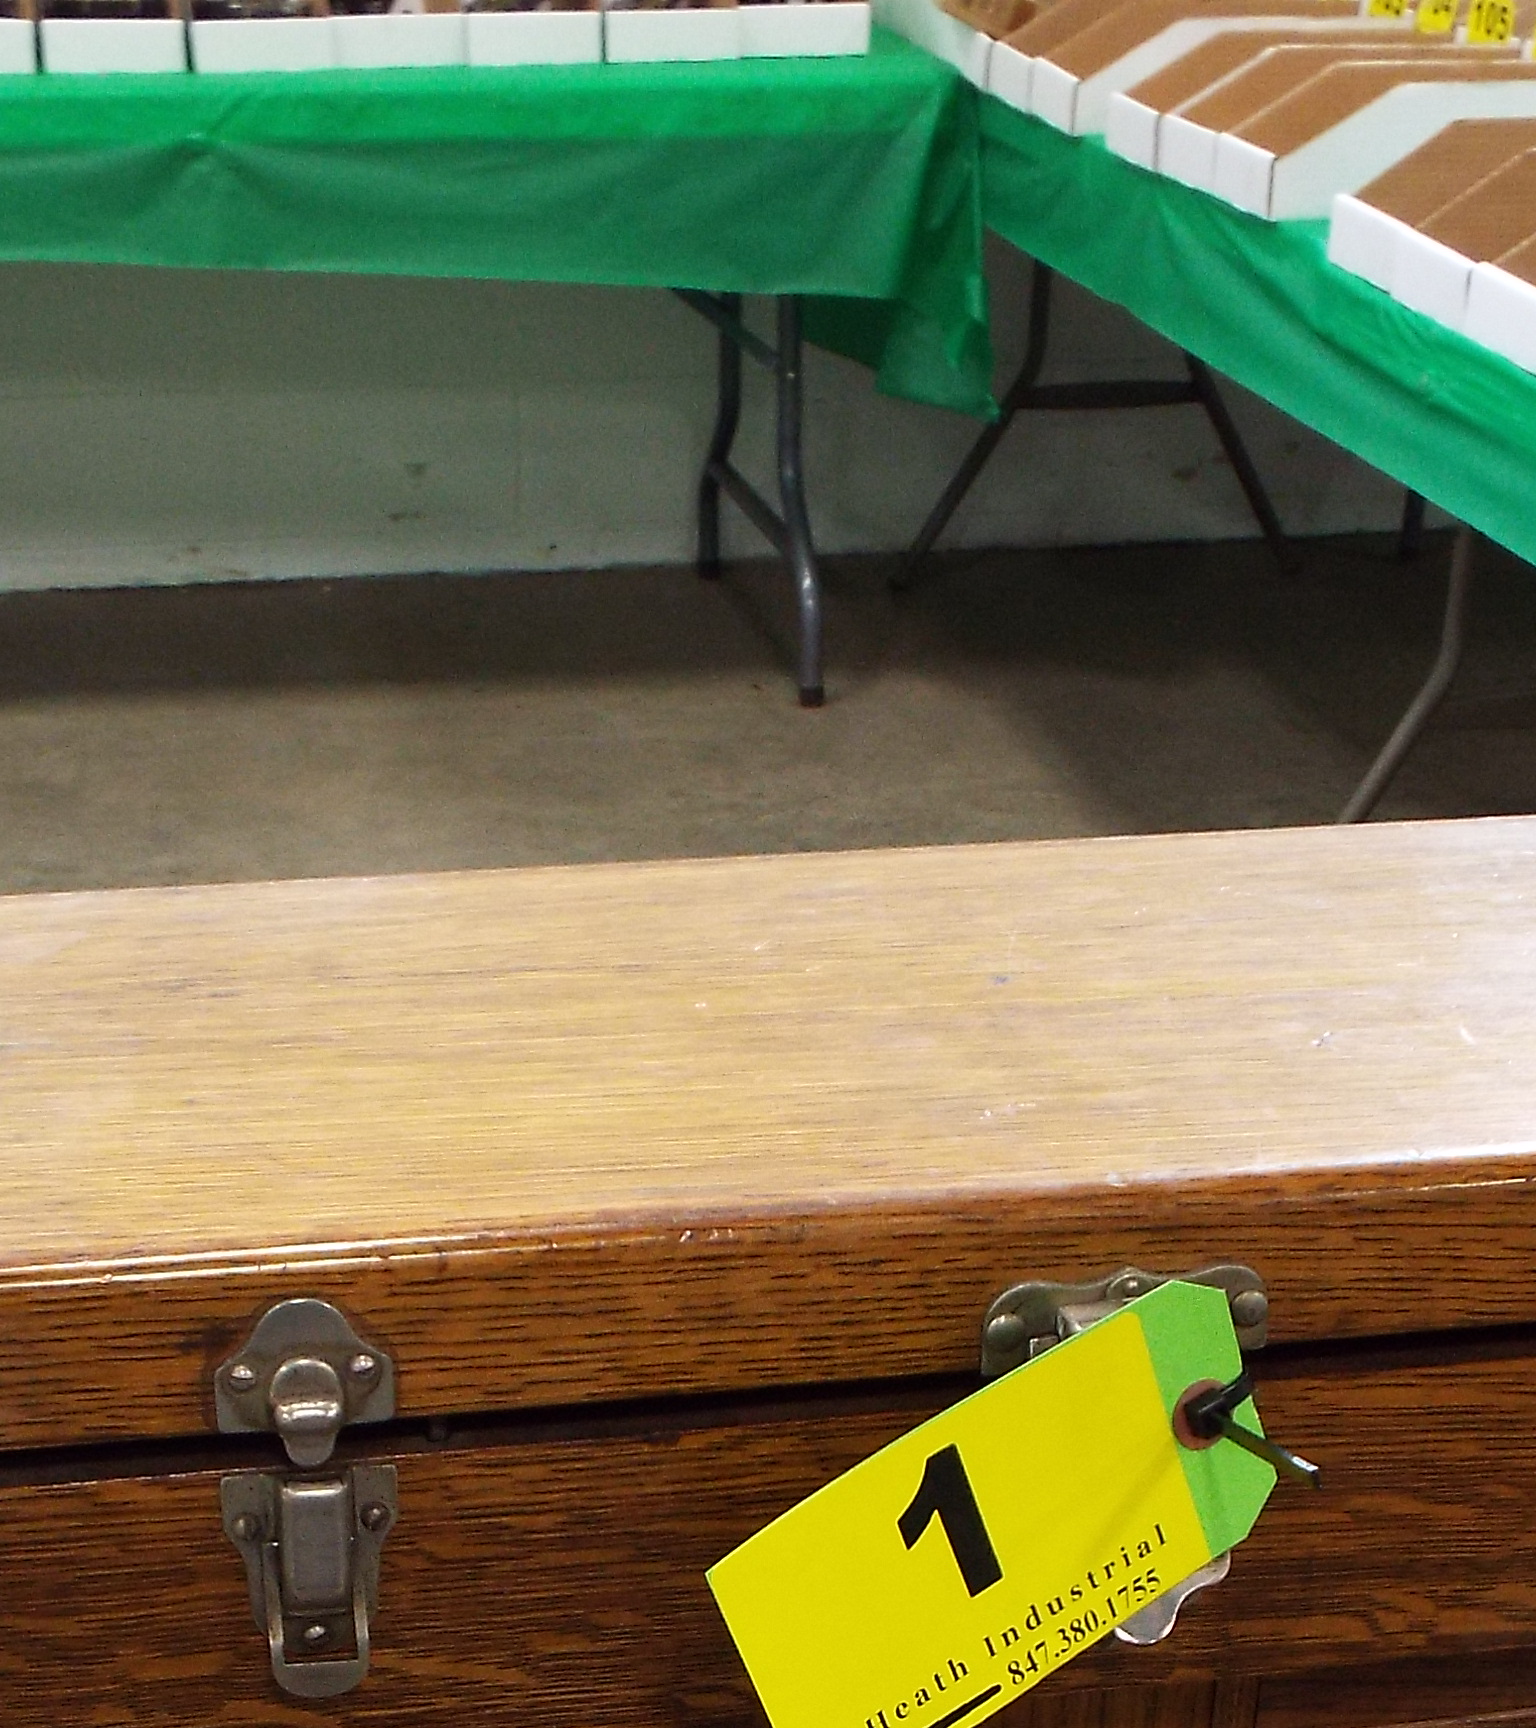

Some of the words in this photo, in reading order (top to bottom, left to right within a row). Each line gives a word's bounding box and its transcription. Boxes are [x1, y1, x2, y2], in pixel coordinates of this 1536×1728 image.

[897, 1443, 1004, 1598] 1
[983, 1523, 1167, 1657] Industrial
[1007, 1568, 1161, 1685] 847.380.1755
